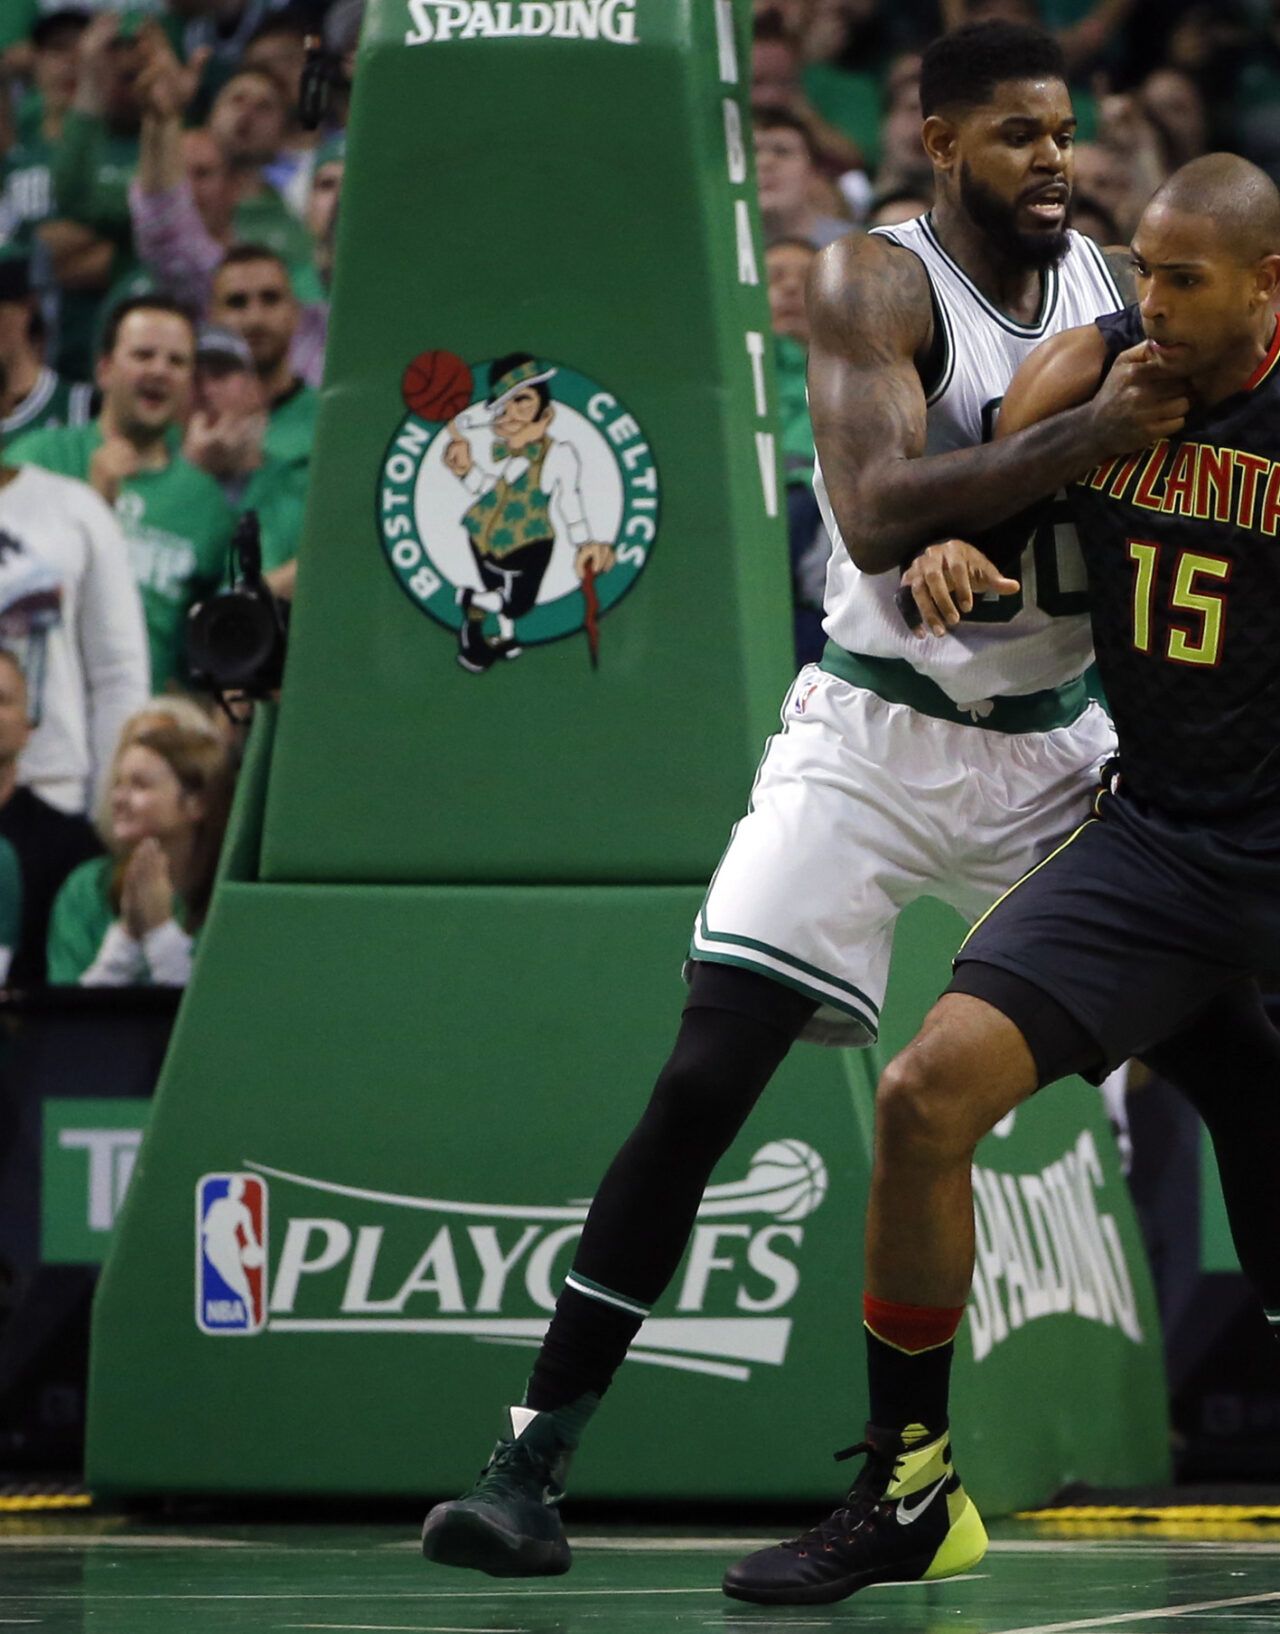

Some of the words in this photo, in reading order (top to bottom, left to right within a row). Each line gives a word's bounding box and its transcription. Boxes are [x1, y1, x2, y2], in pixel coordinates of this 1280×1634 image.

[404, 0, 641, 46] SPALDING
[382, 421, 442, 600] BOSTON
[587, 392, 657, 568] CELTICS
[1127, 540, 1231, 666] 15
[58, 1128, 143, 1232] T
[206, 1299, 246, 1322] NBA
[269, 1218, 804, 1313] PLAYFS
